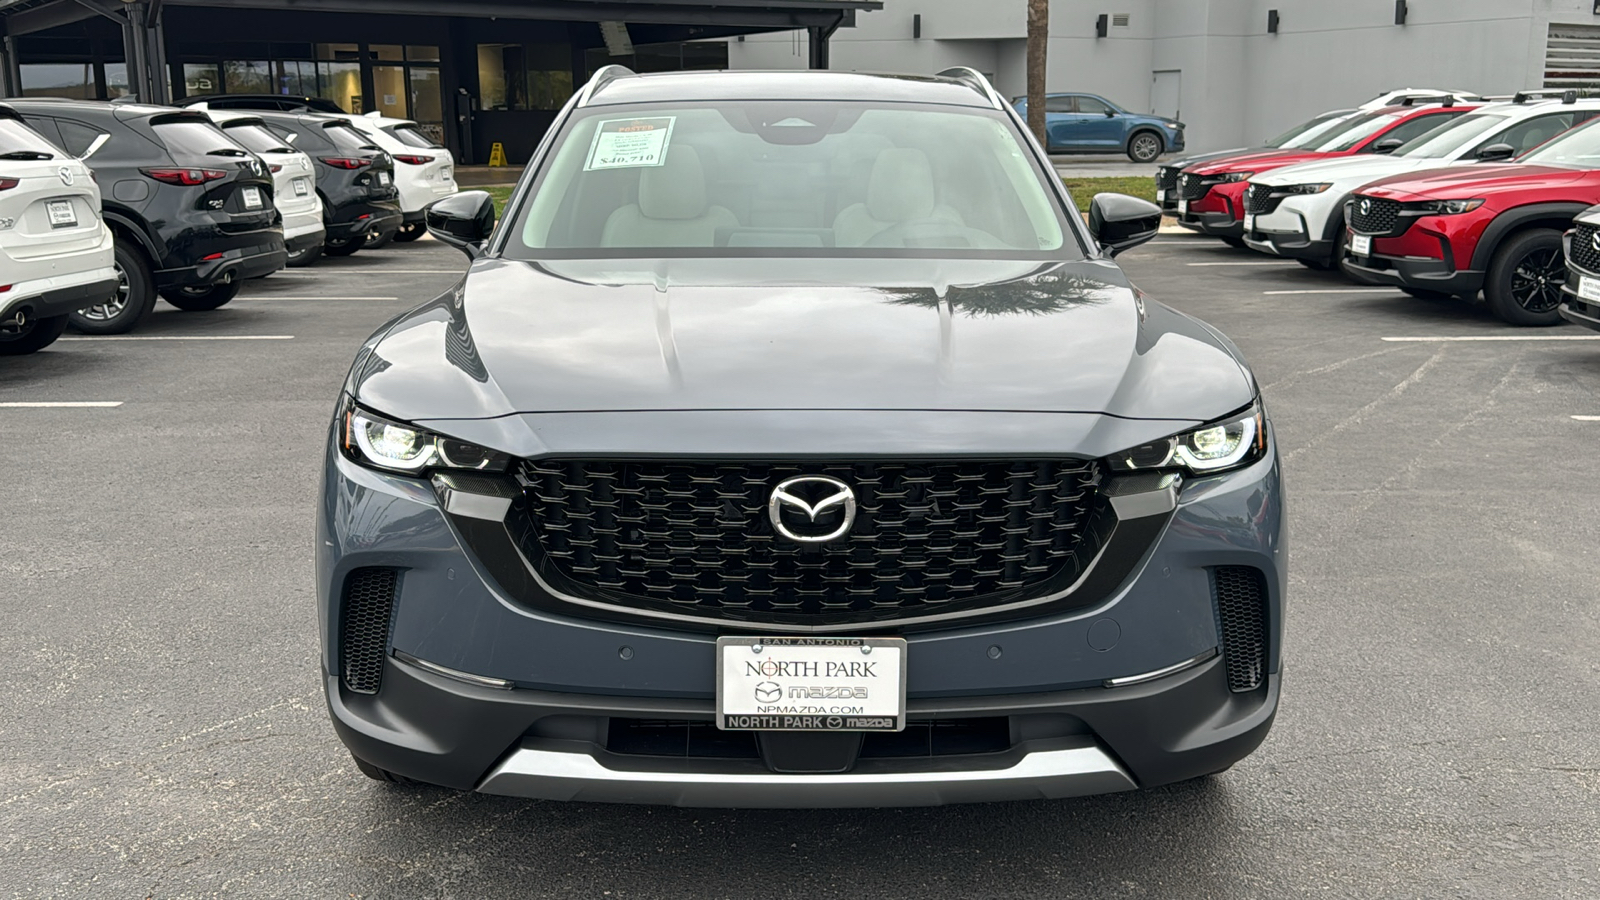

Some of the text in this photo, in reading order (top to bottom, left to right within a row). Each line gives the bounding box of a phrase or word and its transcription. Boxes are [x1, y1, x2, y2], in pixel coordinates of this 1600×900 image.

[745, 660, 878, 677] NORTH PARK
[788, 686, 869, 699] mazda
[757, 705, 864, 714] NPMAZDA.COM
[728, 716, 893, 728] NORTH PARK mazda
